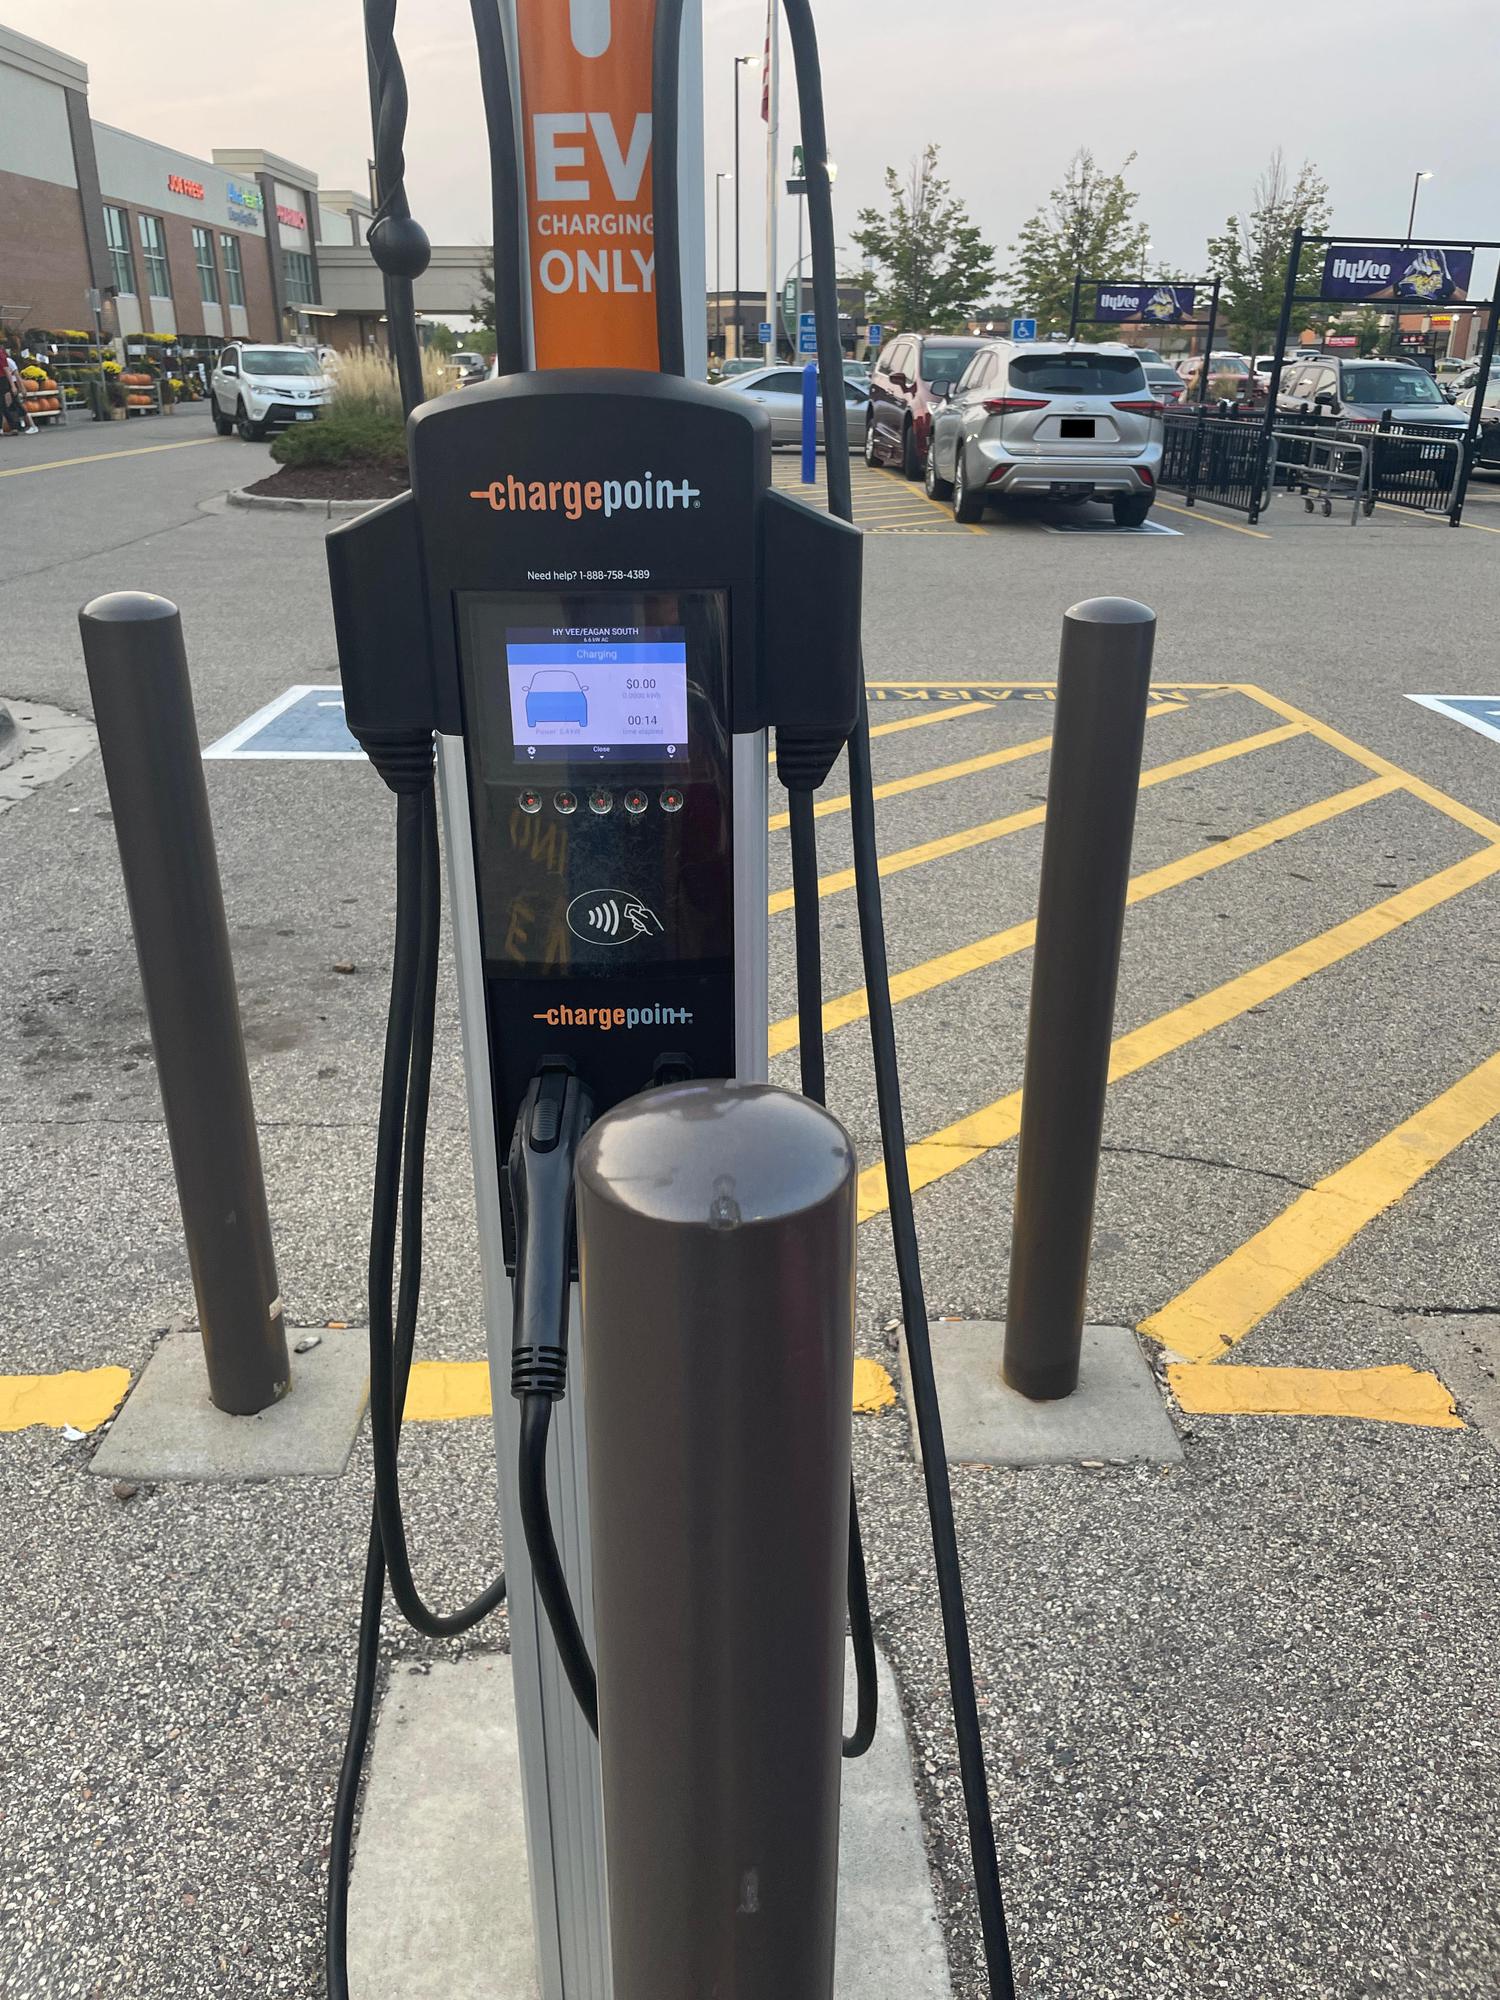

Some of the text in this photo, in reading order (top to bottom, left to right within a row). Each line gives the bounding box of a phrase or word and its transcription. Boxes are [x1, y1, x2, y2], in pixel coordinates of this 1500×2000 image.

[533, 112, 652, 201] EV
[538, 214, 653, 236] CHARGING
[540, 249, 655, 294] ONLY
[470, 471, 700, 520] chargepoint
[527, 570, 650, 581] Need help? 1-888-758-4389
[552, 628, 639, 636] HY VEE/EAGAN SOUTH
[576, 649, 617, 661] Charging
[626, 679, 656, 689] $0.00
[533, 1003, 693, 1030] chargepoint
